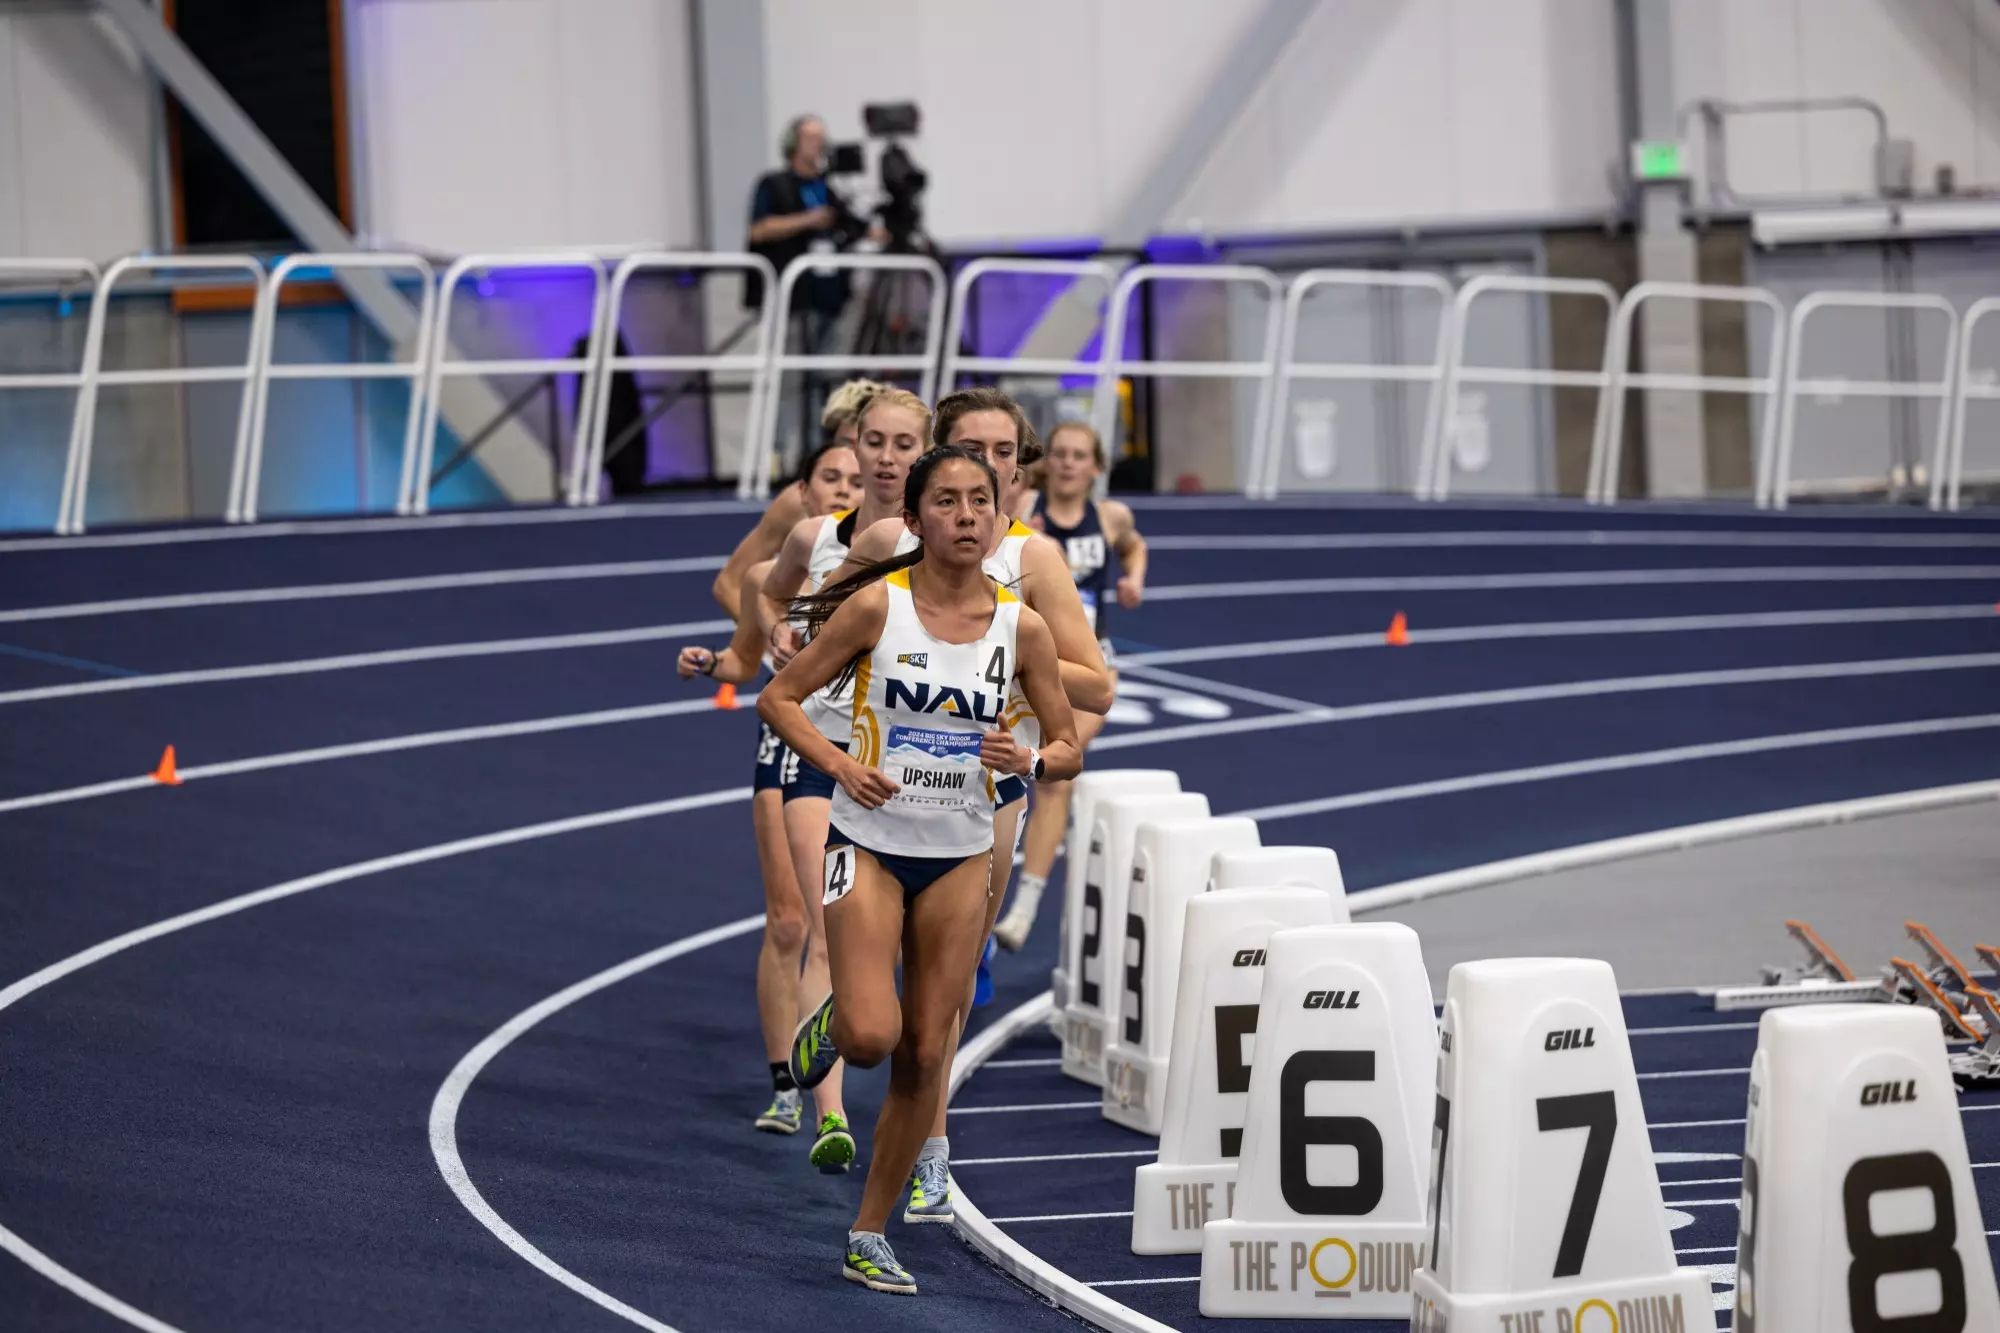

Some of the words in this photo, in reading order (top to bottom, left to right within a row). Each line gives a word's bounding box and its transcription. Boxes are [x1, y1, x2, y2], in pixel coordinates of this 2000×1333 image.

[985, 646, 1006, 695] 4
[885, 678, 1005, 724] NAU
[896, 734, 936, 745] CONFERENCE
[908, 730, 924, 738] 2024
[902, 767, 967, 790] UPSHAW
[829, 851, 848, 896] 4
[1081, 884, 1103, 1006] 2
[1125, 912, 1146, 1045] 3
[1303, 991, 1361, 1010] GILL
[1544, 1027, 1596, 1052] GILL
[1860, 1079, 1918, 1107] GILL
[1280, 1050, 1384, 1216] 6
[1536, 1090, 1618, 1279] 7
[1843, 1150, 1968, 1333] 8
[1229, 1240, 1279, 1292] THE
[1291, 1237, 1425, 1293] PODIUM
